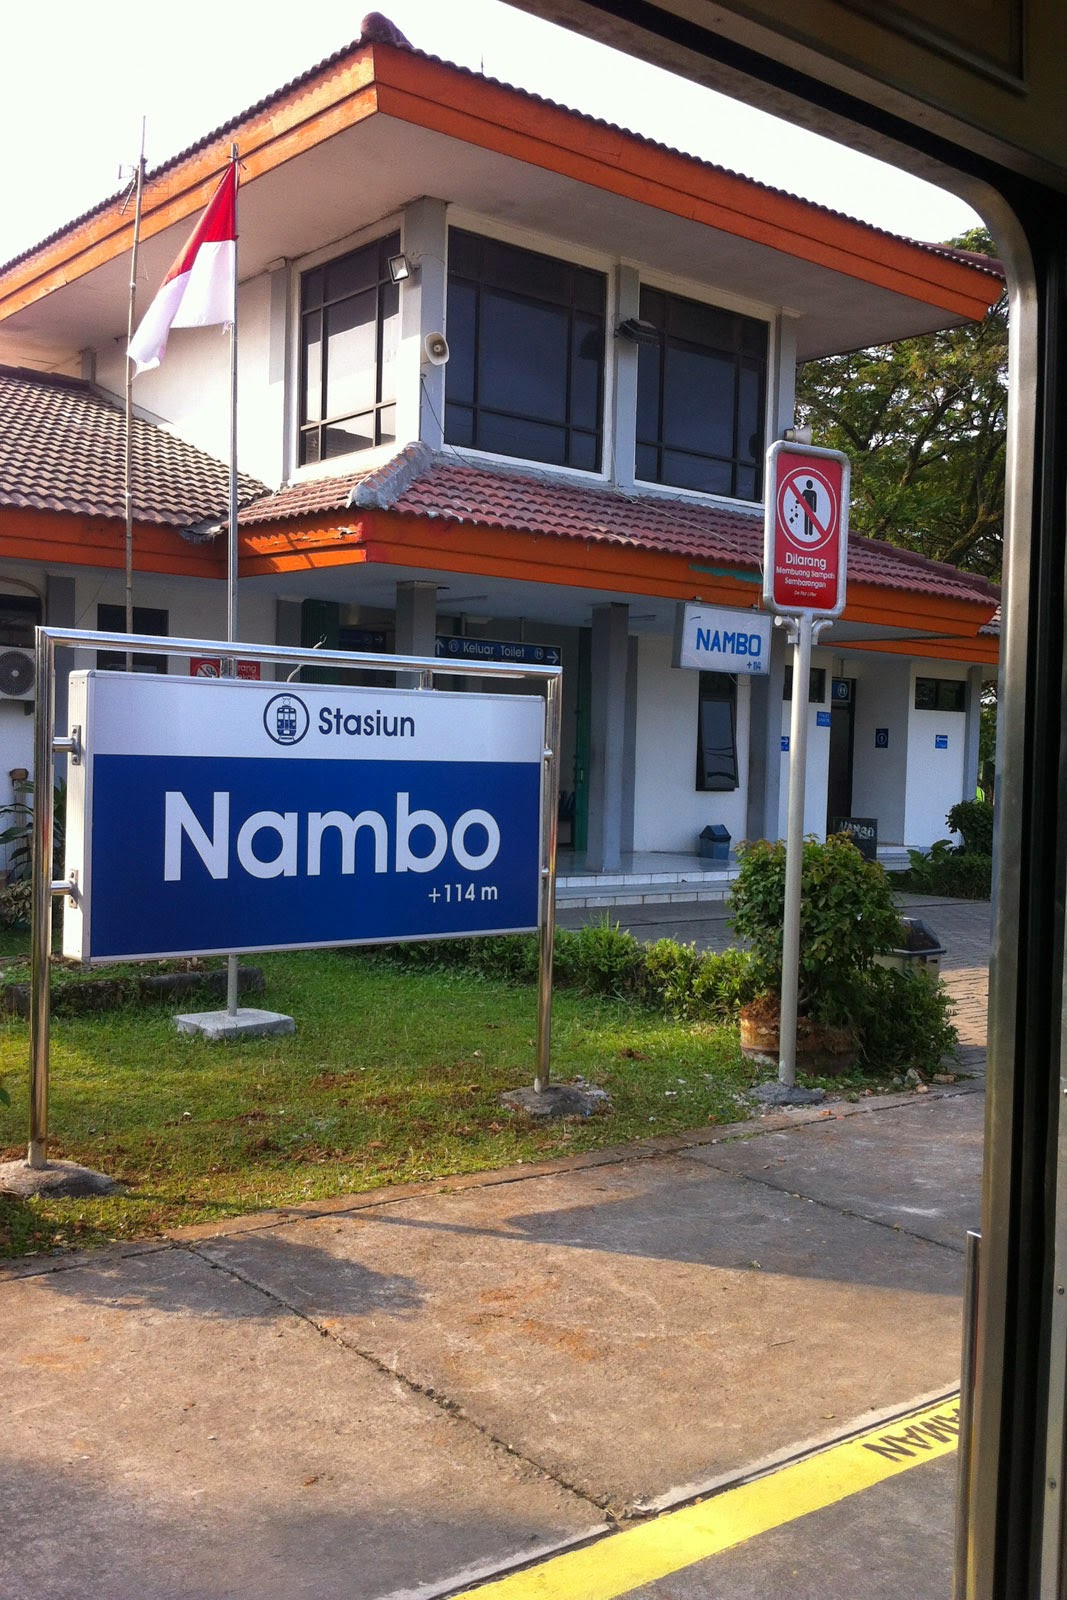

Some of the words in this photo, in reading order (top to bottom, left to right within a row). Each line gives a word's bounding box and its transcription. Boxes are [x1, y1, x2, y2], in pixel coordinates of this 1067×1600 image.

[785, 552, 827, 570] Dilarang
[776, 566, 810, 577] Membuang
[811, 571, 835, 579] Sampah
[785, 577, 826, 588] Sembarangan
[463, 642, 494, 655] Keluar
[500, 645, 525, 658] Toilet
[696, 627, 762, 657] NAMBO
[318, 706, 415, 737] Stasiun
[164, 791, 500, 882] Nambo
[428, 883, 475, 903] +114
[481, 886, 498, 901] m
